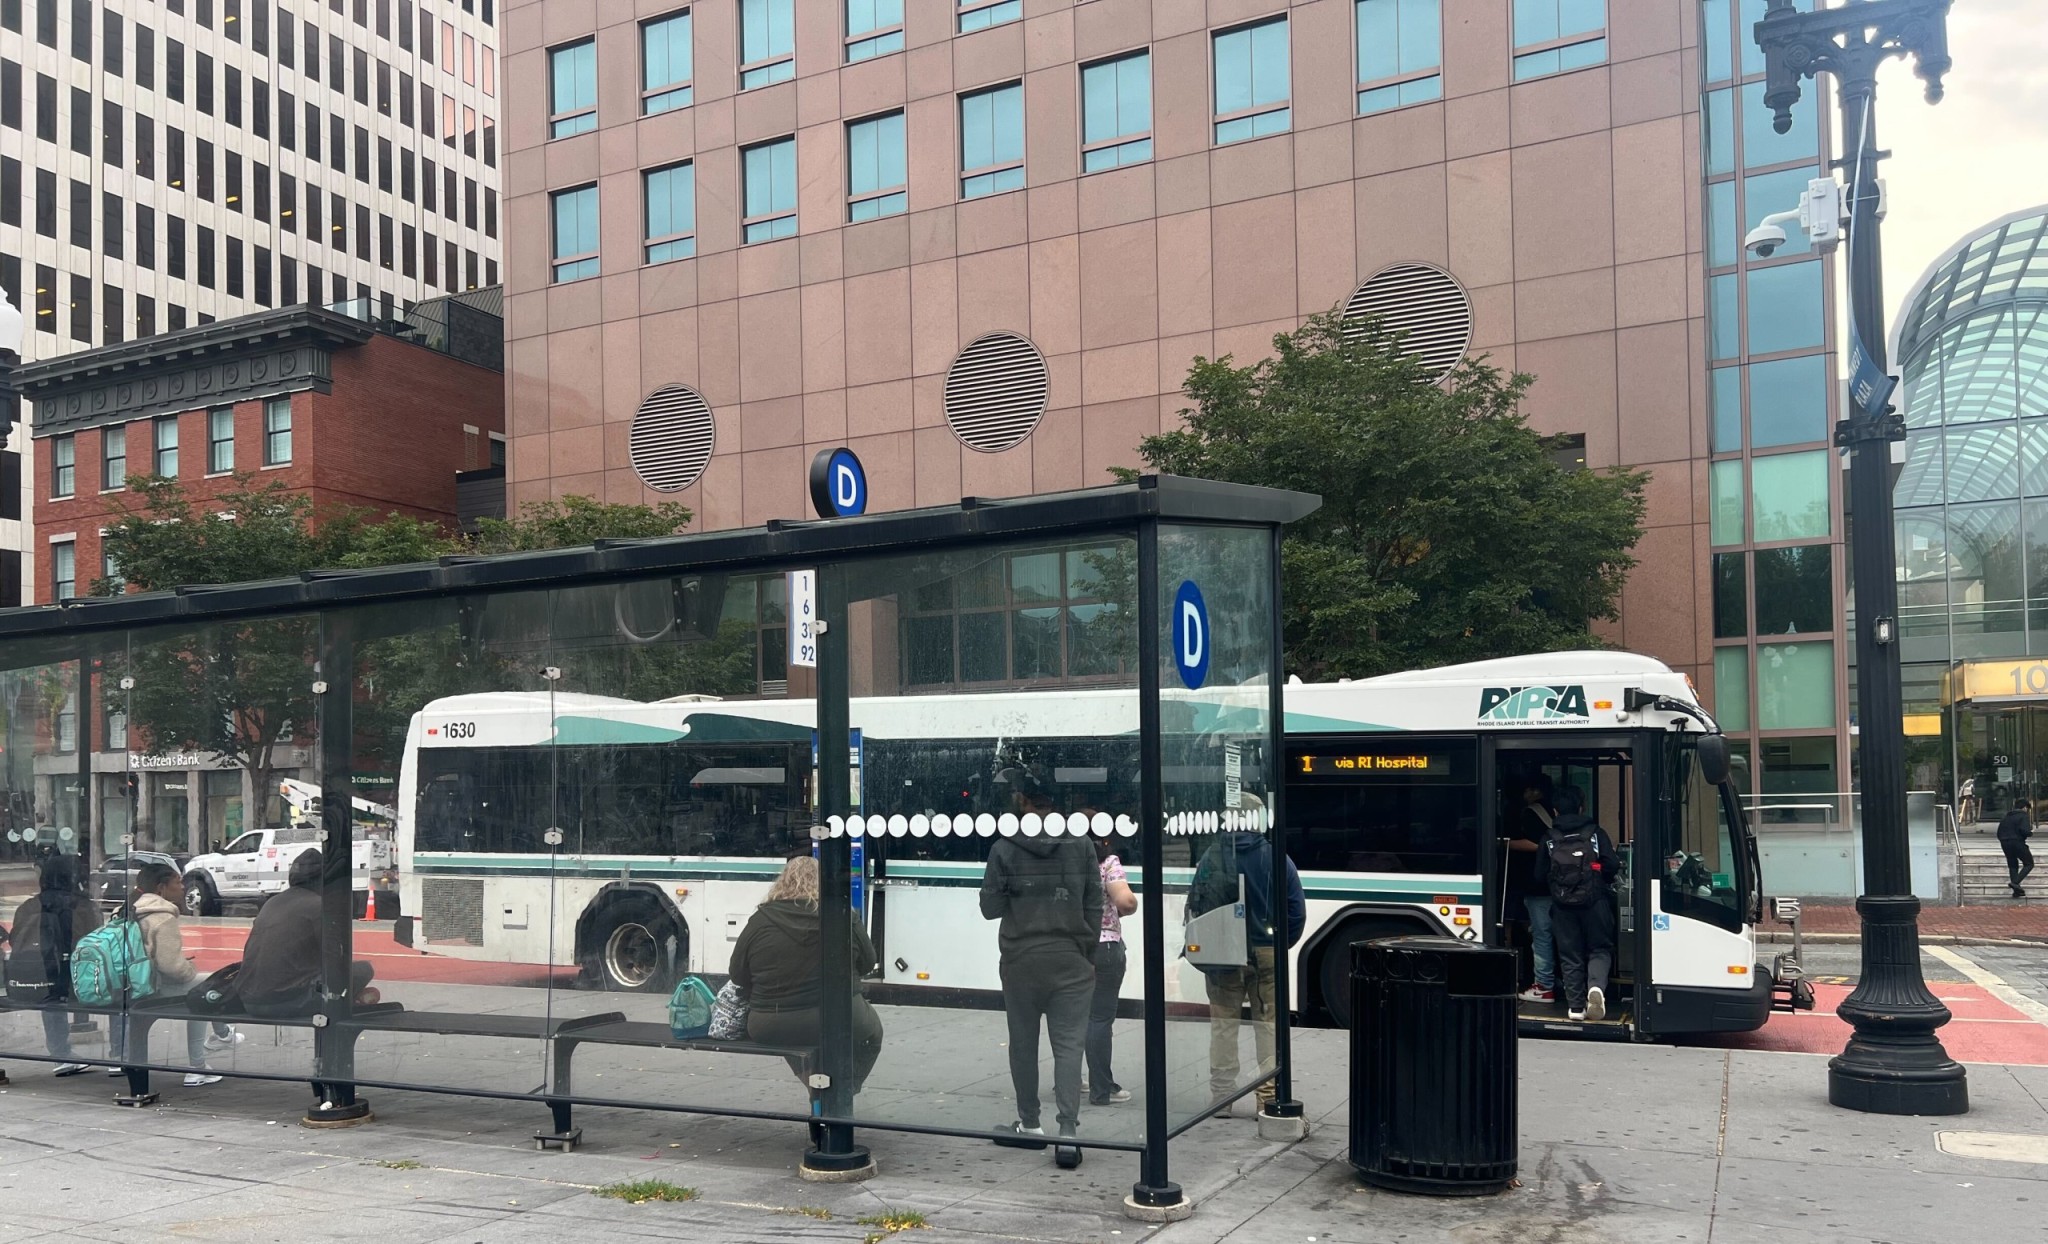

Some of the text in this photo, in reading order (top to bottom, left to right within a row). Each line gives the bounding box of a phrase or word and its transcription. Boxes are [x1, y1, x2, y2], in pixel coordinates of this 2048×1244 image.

[837, 464, 857, 507] D
[803, 575, 808, 592] 1
[803, 599, 810, 615] 6
[1183, 601, 1203, 668] D
[801, 645, 814, 662] 92
[1478, 685, 1589, 719] RIPTA
[442, 722, 476, 738] 1630
[177, 752, 201, 766] Bank
[1302, 755, 1428, 772] 1 via RI Hospital
[1993, 755, 2008, 764] 50
[9, 979, 55, 990] Champion
